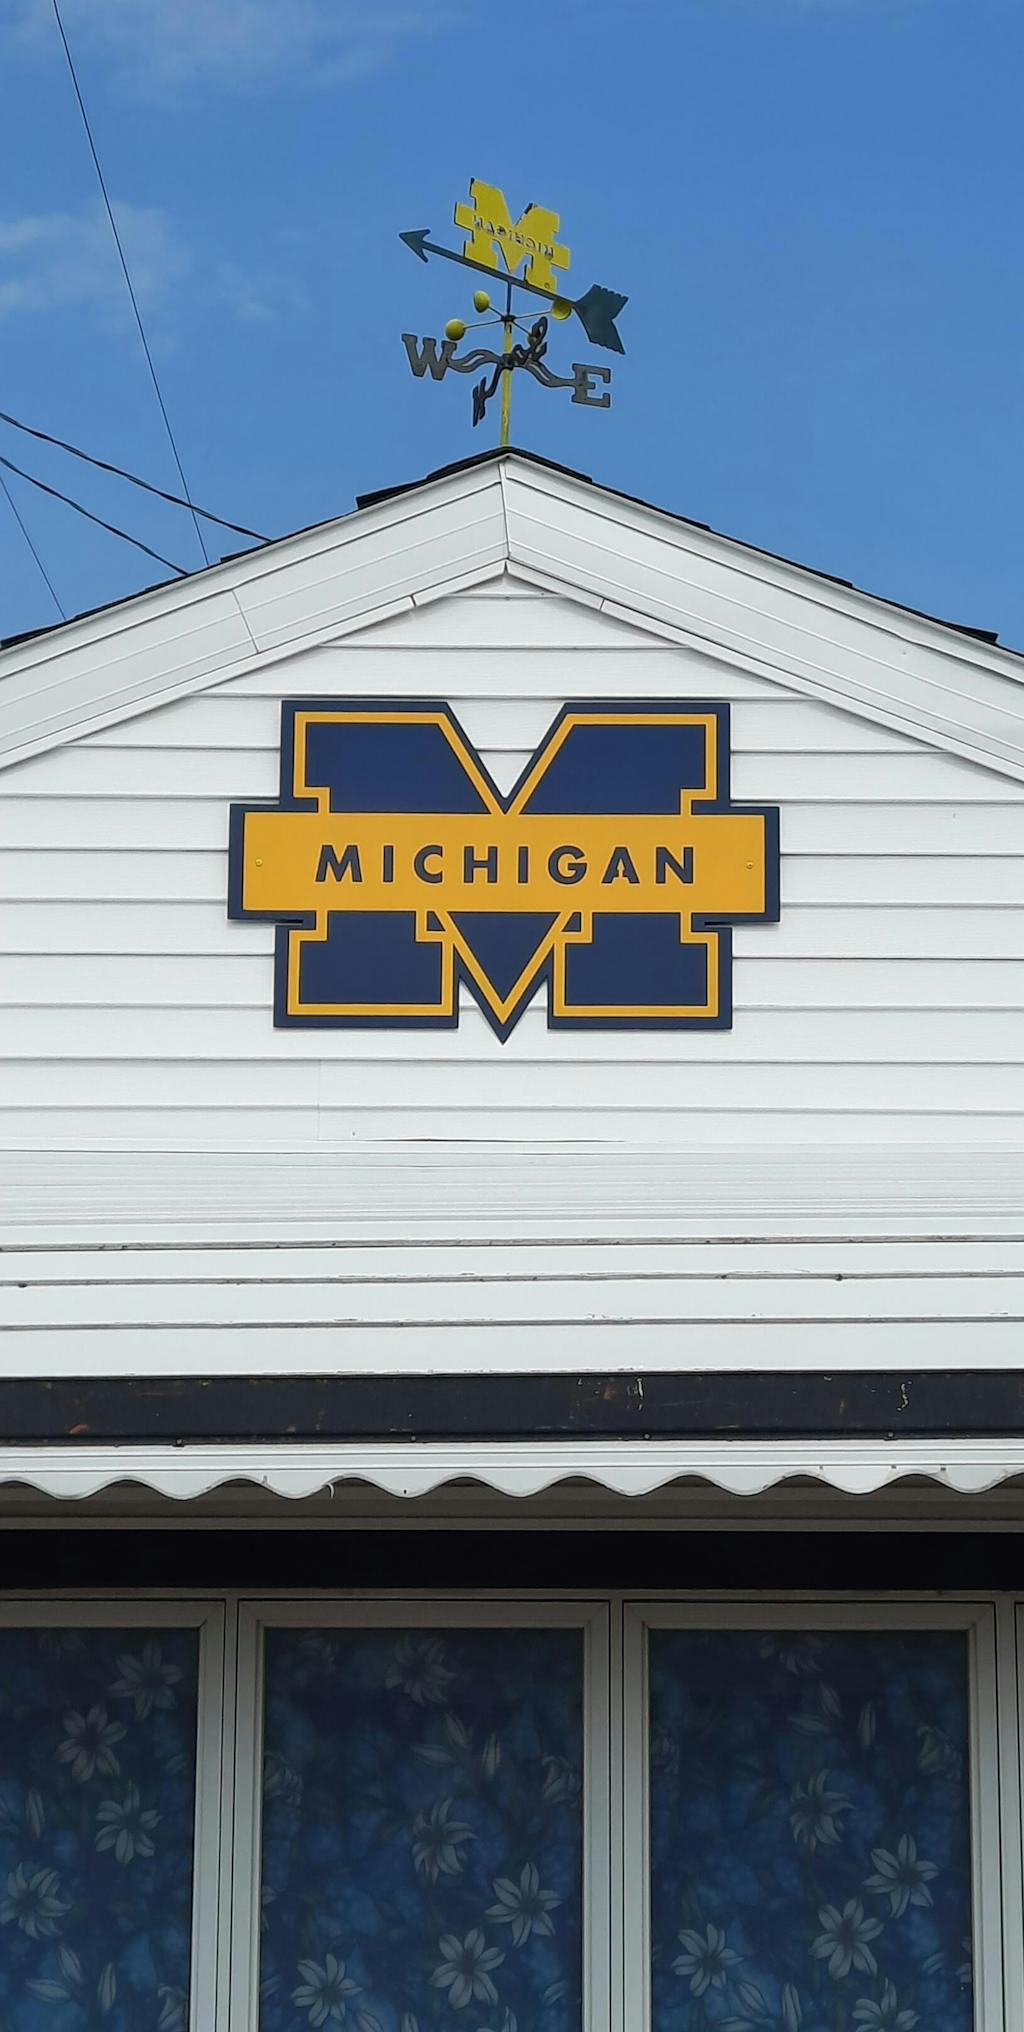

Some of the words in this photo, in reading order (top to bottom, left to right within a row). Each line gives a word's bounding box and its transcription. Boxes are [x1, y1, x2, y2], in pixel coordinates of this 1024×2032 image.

[454, 178, 570, 293] M
[401, 334, 457, 381] W
[571, 363, 611, 408] E
[228, 700, 780, 1044] M
[315, 844, 695, 885] MICHIGAN
